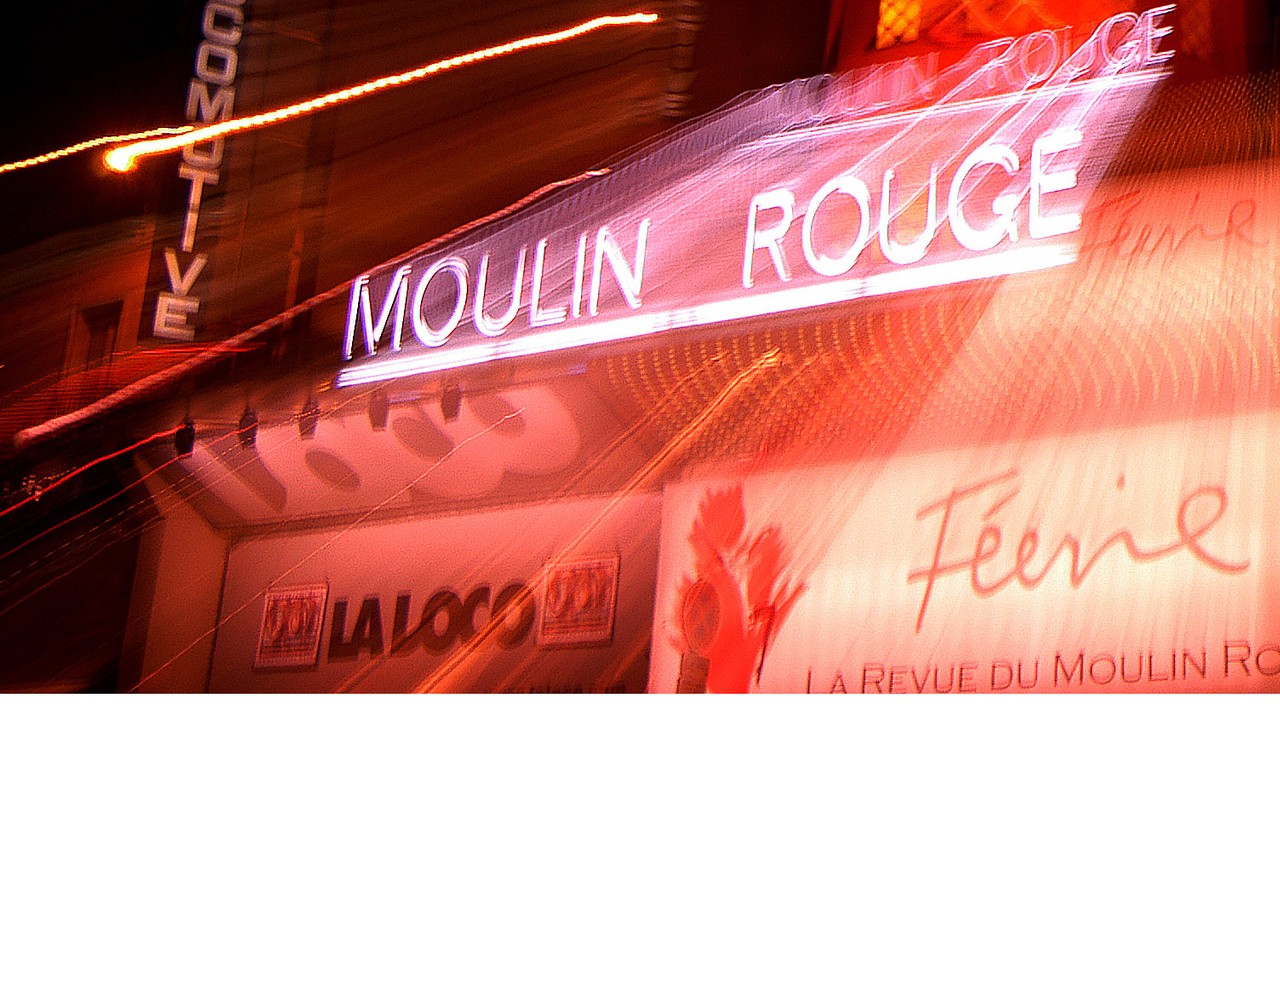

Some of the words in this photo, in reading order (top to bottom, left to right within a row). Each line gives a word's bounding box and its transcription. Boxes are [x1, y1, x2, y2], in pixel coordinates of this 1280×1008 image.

[343, 218, 652, 361] MOULIN
[742, 128, 1084, 290] ROUGE
[1053, 647, 1207, 688] MOULIN
